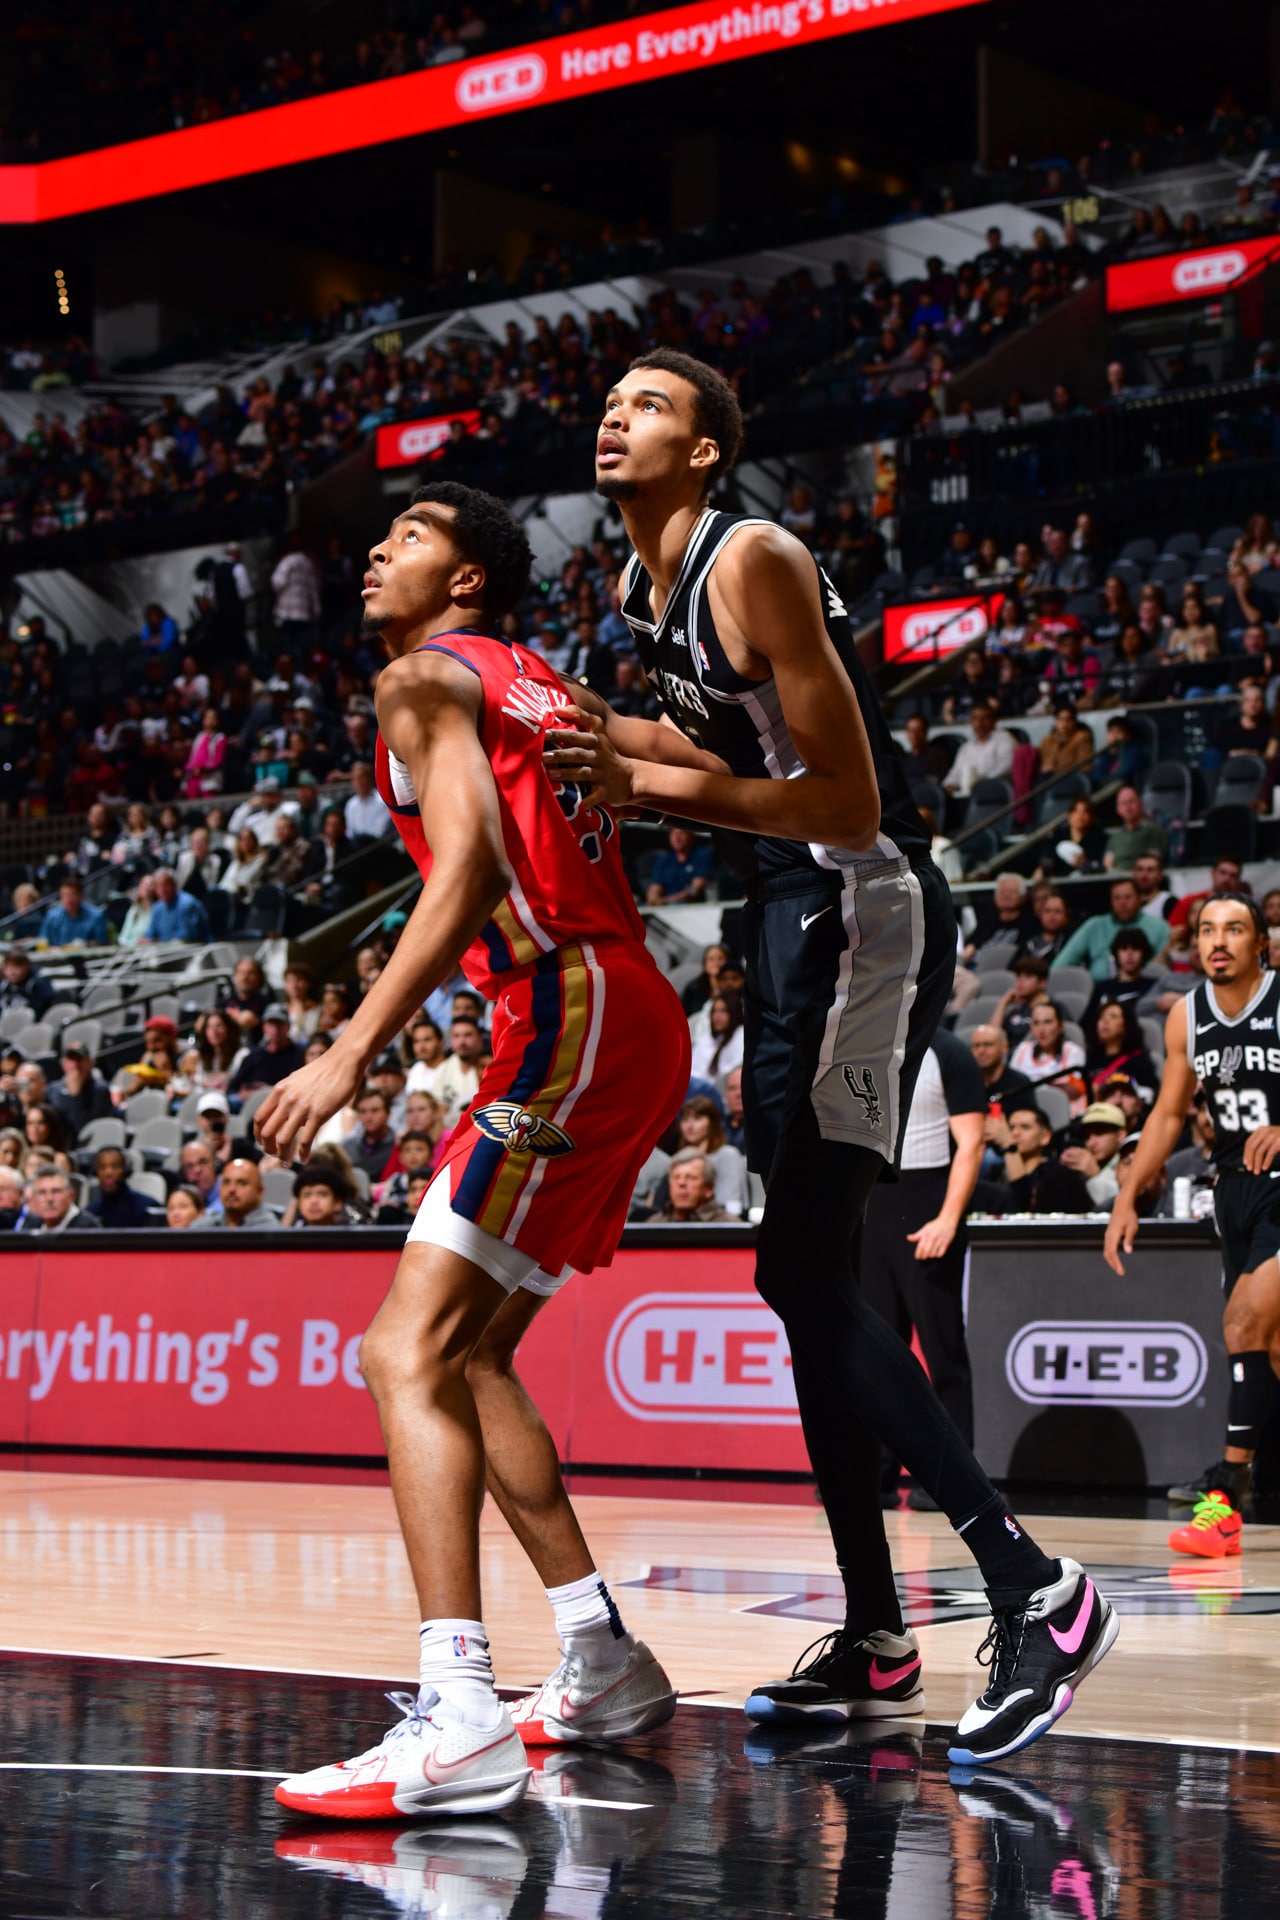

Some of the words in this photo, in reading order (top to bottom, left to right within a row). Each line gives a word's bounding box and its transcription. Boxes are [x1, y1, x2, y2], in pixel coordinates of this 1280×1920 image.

[560, 41, 632, 82] Here
[635, 0, 825, 64] Everything's
[1213, 1087, 1271, 1133] 33
[0, 1313, 281, 1406] rything's
